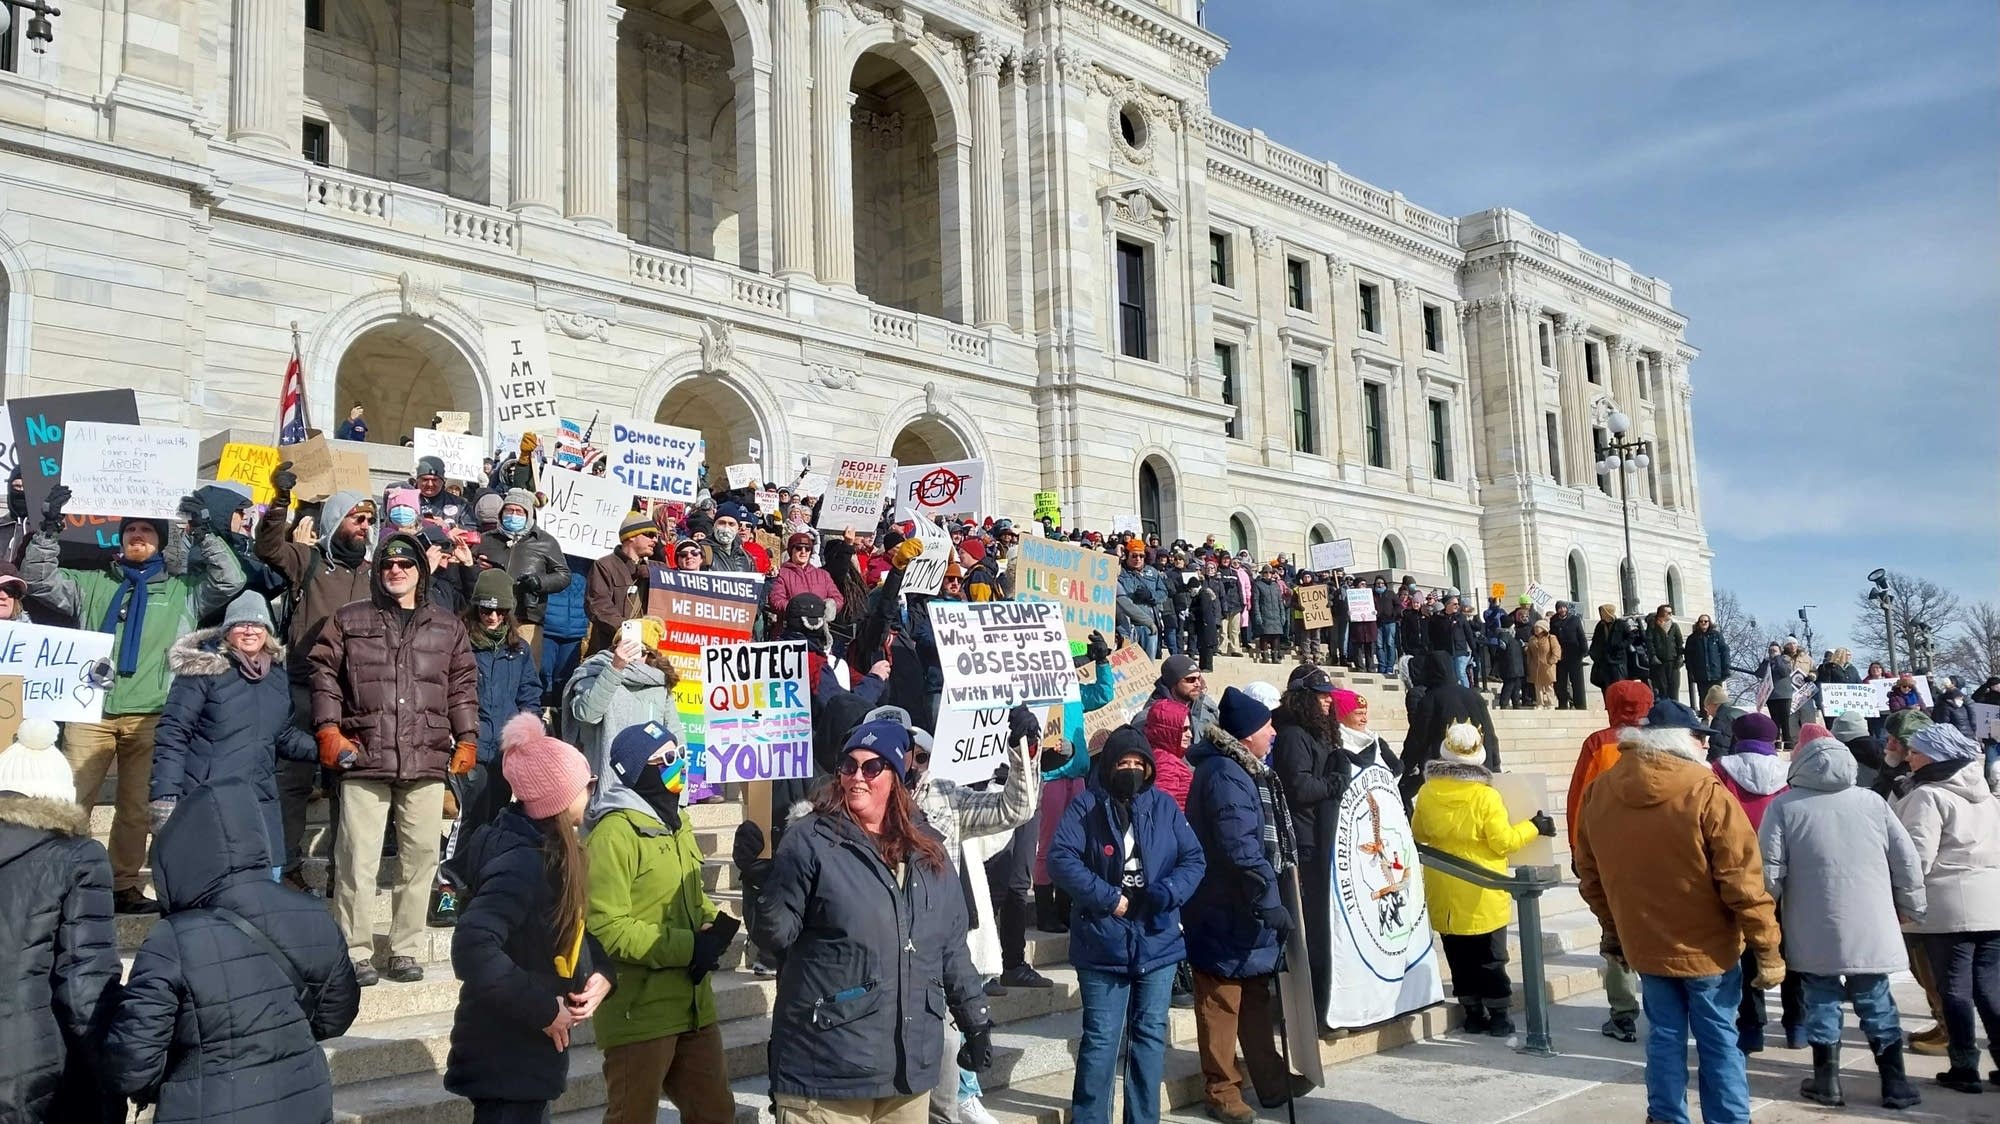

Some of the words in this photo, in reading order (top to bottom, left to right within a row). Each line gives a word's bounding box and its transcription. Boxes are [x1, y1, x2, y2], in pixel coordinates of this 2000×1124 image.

[511, 340, 523, 355] I
[511, 361, 533, 377] AM
[500, 380, 546, 400] VERY
[498, 400, 556, 422] UPSET
[26, 414, 62, 446] No
[75, 427, 98, 441] All
[614, 424, 696, 458] Democracy
[427, 433, 464, 450] SAVE
[40, 456, 60, 477] is
[226, 445, 273, 467] HUMAN
[623, 449, 651, 465] dies
[656, 456, 685, 471] with
[841, 460, 888, 473] PEOPLE
[230, 463, 262, 484] ARE
[612, 465, 692, 496] SILENCE
[839, 470, 864, 479] HAVE
[868, 473, 885, 481] THE
[551, 476, 584, 515] WE
[595, 498, 621, 517] THE
[833, 496, 851, 504] THE
[852, 498, 877, 507] WORK
[847, 490, 880, 498] REDEEM
[830, 503, 845, 511] OF
[845, 505, 876, 515] FOOLS
[544, 513, 616, 550] PEOPLE
[1023, 539, 1084, 571] NOBODY
[1090, 556, 1109, 581] IS
[660, 570, 675, 585] IN
[677, 573, 709, 591] THIS
[712, 579, 758, 600] HOUSE,
[1027, 567, 1088, 603] ILLEGAL
[1092, 584, 1114, 606] ON
[1301, 590, 1327, 603] ELON
[672, 598, 692, 615] WE
[695, 602, 750, 623] BELIEVE:
[935, 607, 968, 629] Hey
[968, 603, 1059, 626] TRUMP:
[1079, 608, 1114, 633] LAND
[1306, 611, 1329, 622] EVIL
[670, 630, 708, 646] HUMAN
[938, 628, 976, 652] Why
[983, 633, 1008, 644] are
[1014, 631, 1039, 650] you
[35, 637, 78, 668] ALL
[670, 655, 700, 669] OMEN
[706, 643, 807, 683] PROTECT
[956, 650, 1067, 676] OBSESSED
[1111, 646, 1138, 667] OVE
[24, 677, 63, 701] TER!!
[688, 693, 704, 704] LIV
[710, 681, 804, 711] QUEER
[952, 731, 1008, 763] SILEN
[707, 741, 809, 782] YOUTH
[1341, 877, 1356, 915] THE
